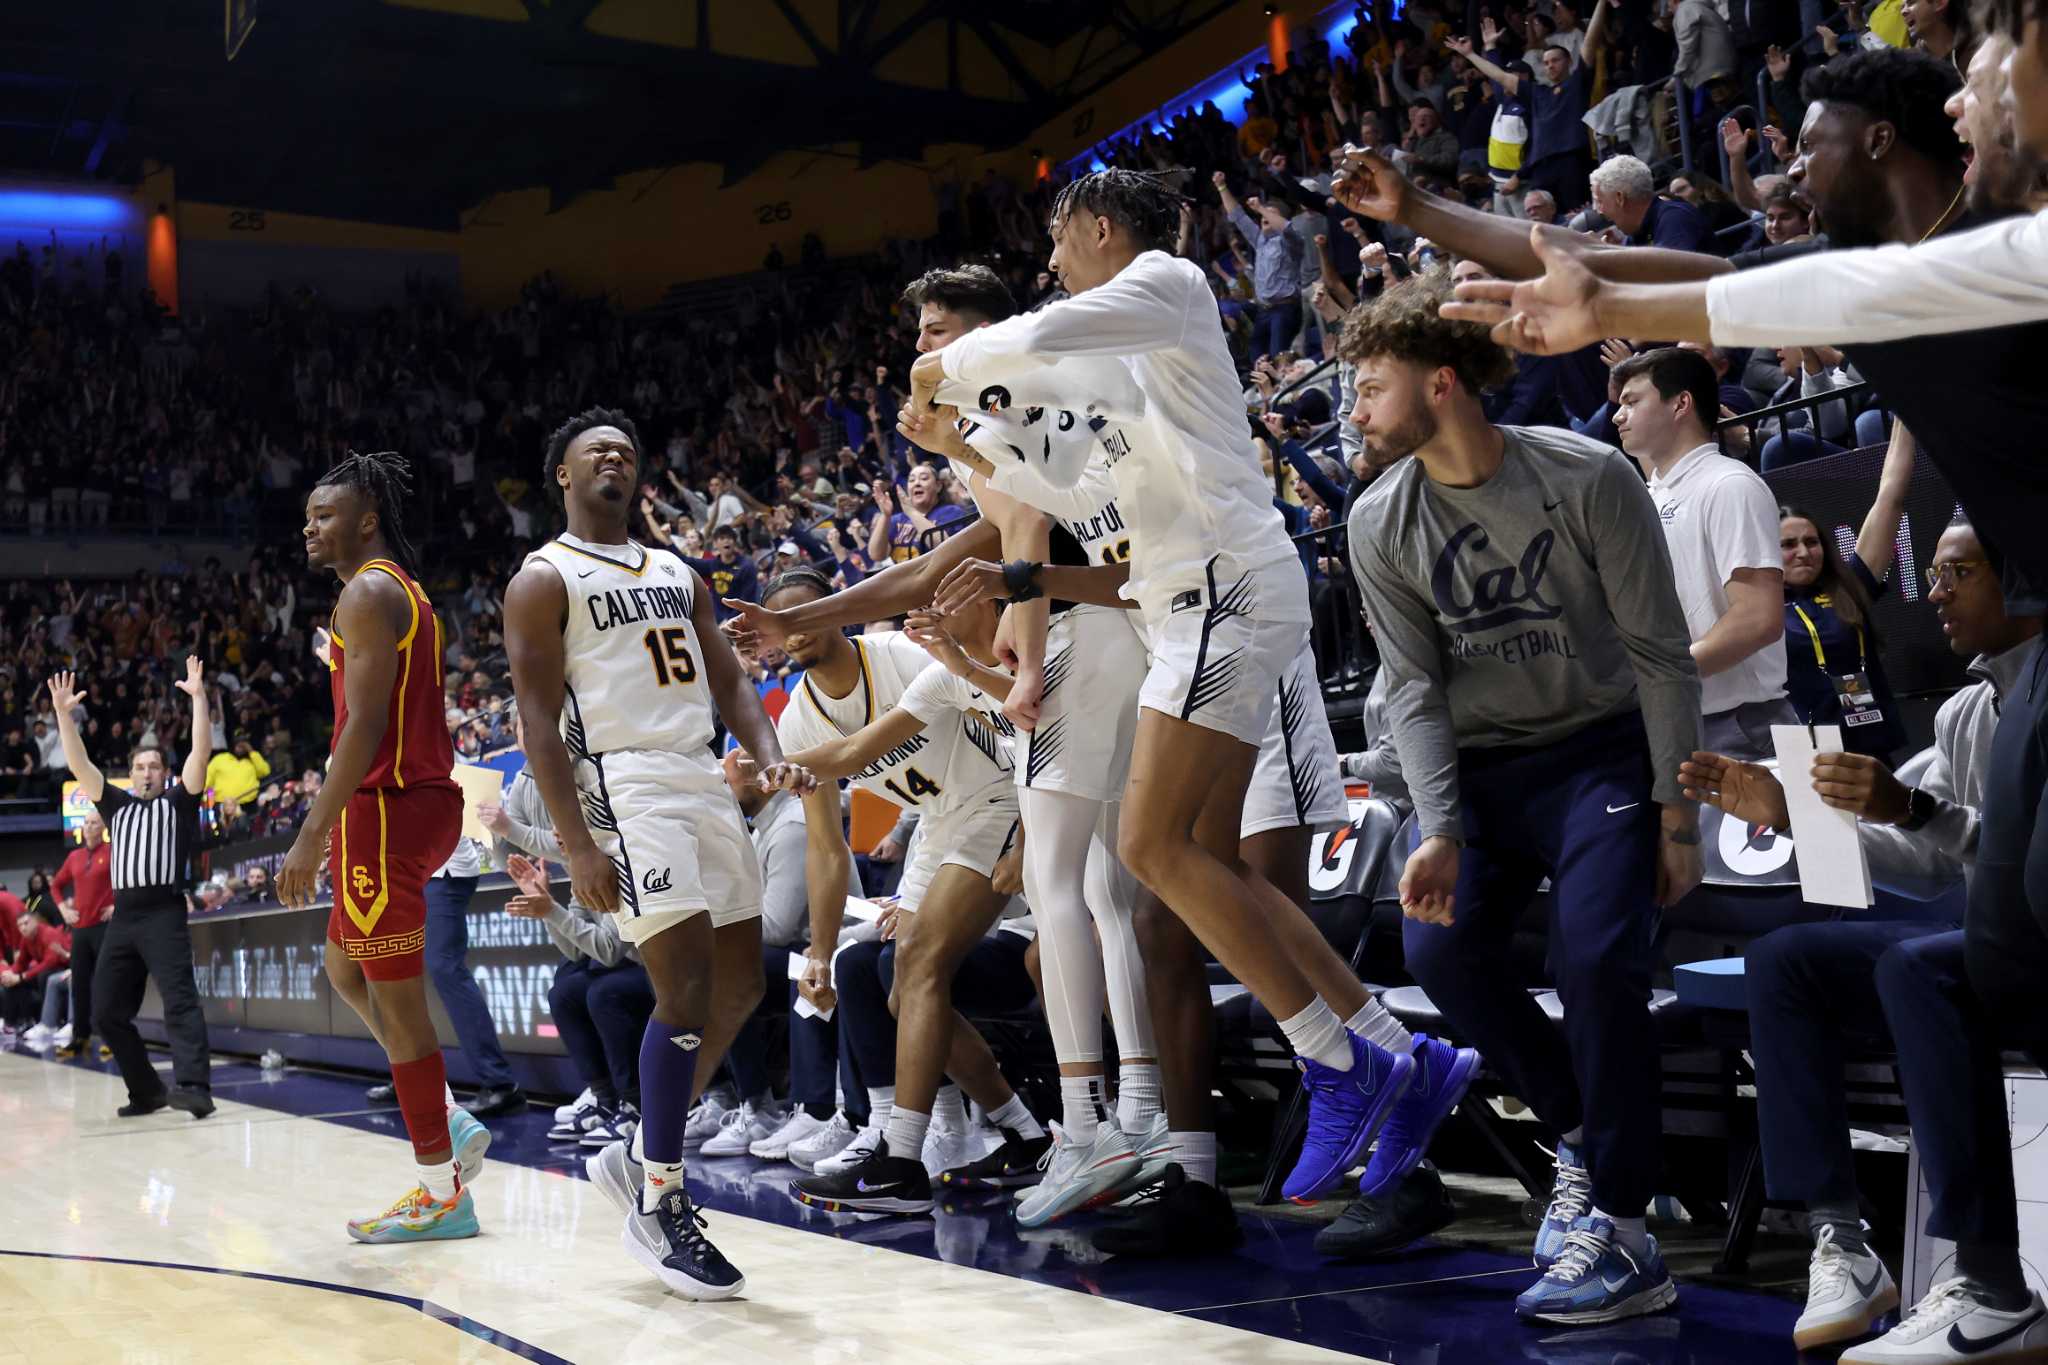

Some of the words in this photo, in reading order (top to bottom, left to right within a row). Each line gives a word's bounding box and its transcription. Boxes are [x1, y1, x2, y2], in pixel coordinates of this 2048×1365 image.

[228, 211, 265, 231] 25
[1431, 522, 1562, 634] Cal
[642, 627, 698, 687] 15
[1452, 629, 1577, 664] BASKETBALL
[884, 766, 941, 806] 14
[643, 867, 672, 896] Cal
